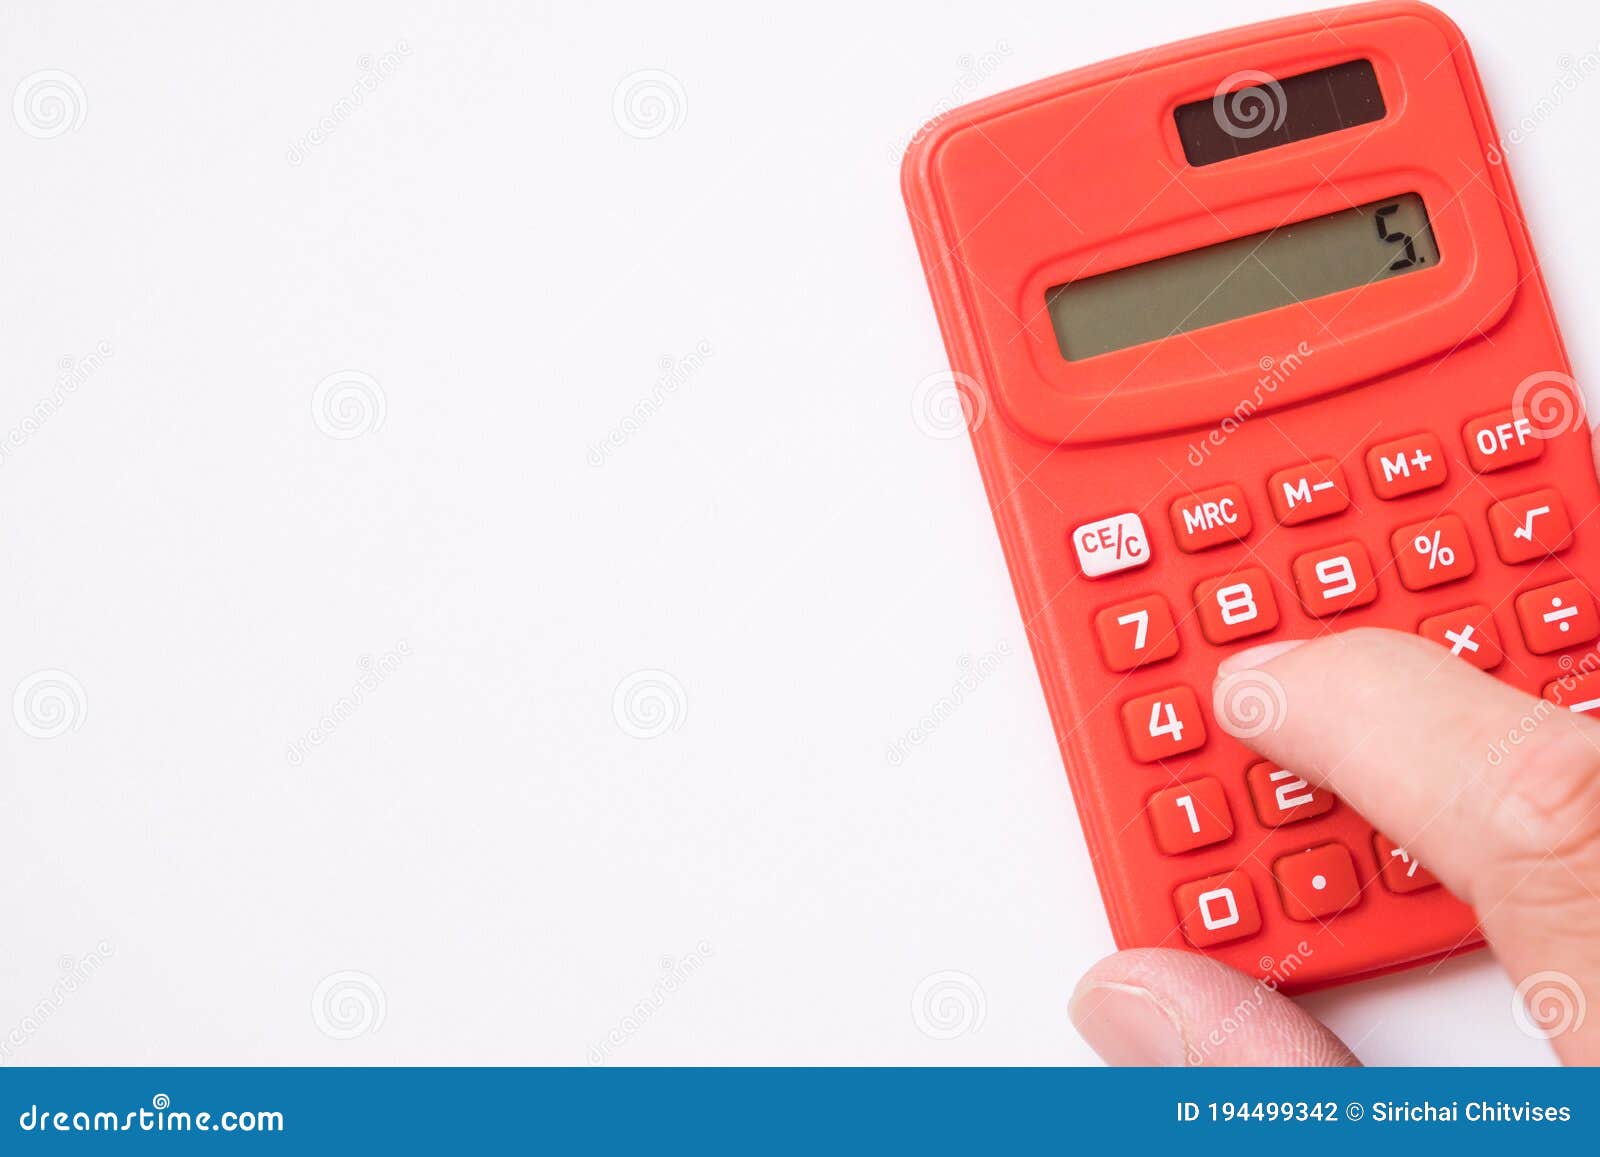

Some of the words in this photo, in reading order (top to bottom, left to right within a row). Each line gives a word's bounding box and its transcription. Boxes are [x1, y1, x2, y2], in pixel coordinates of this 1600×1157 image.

[1375, 204, 1425, 271] 5.
[1477, 418, 1531, 454] OFF
[1381, 450, 1431, 481] M+
[1183, 498, 1237, 534] MRC
[1081, 523, 1142, 560] CE/C
[1315, 556, 1357, 599] 9
[1216, 583, 1258, 625] 8
[1118, 610, 1149, 650] 7
[1149, 702, 1184, 742] 4
[1269, 770, 1314, 811] 2
[1176, 796, 1201, 833] 1
[1199, 888, 1240, 931] 0
